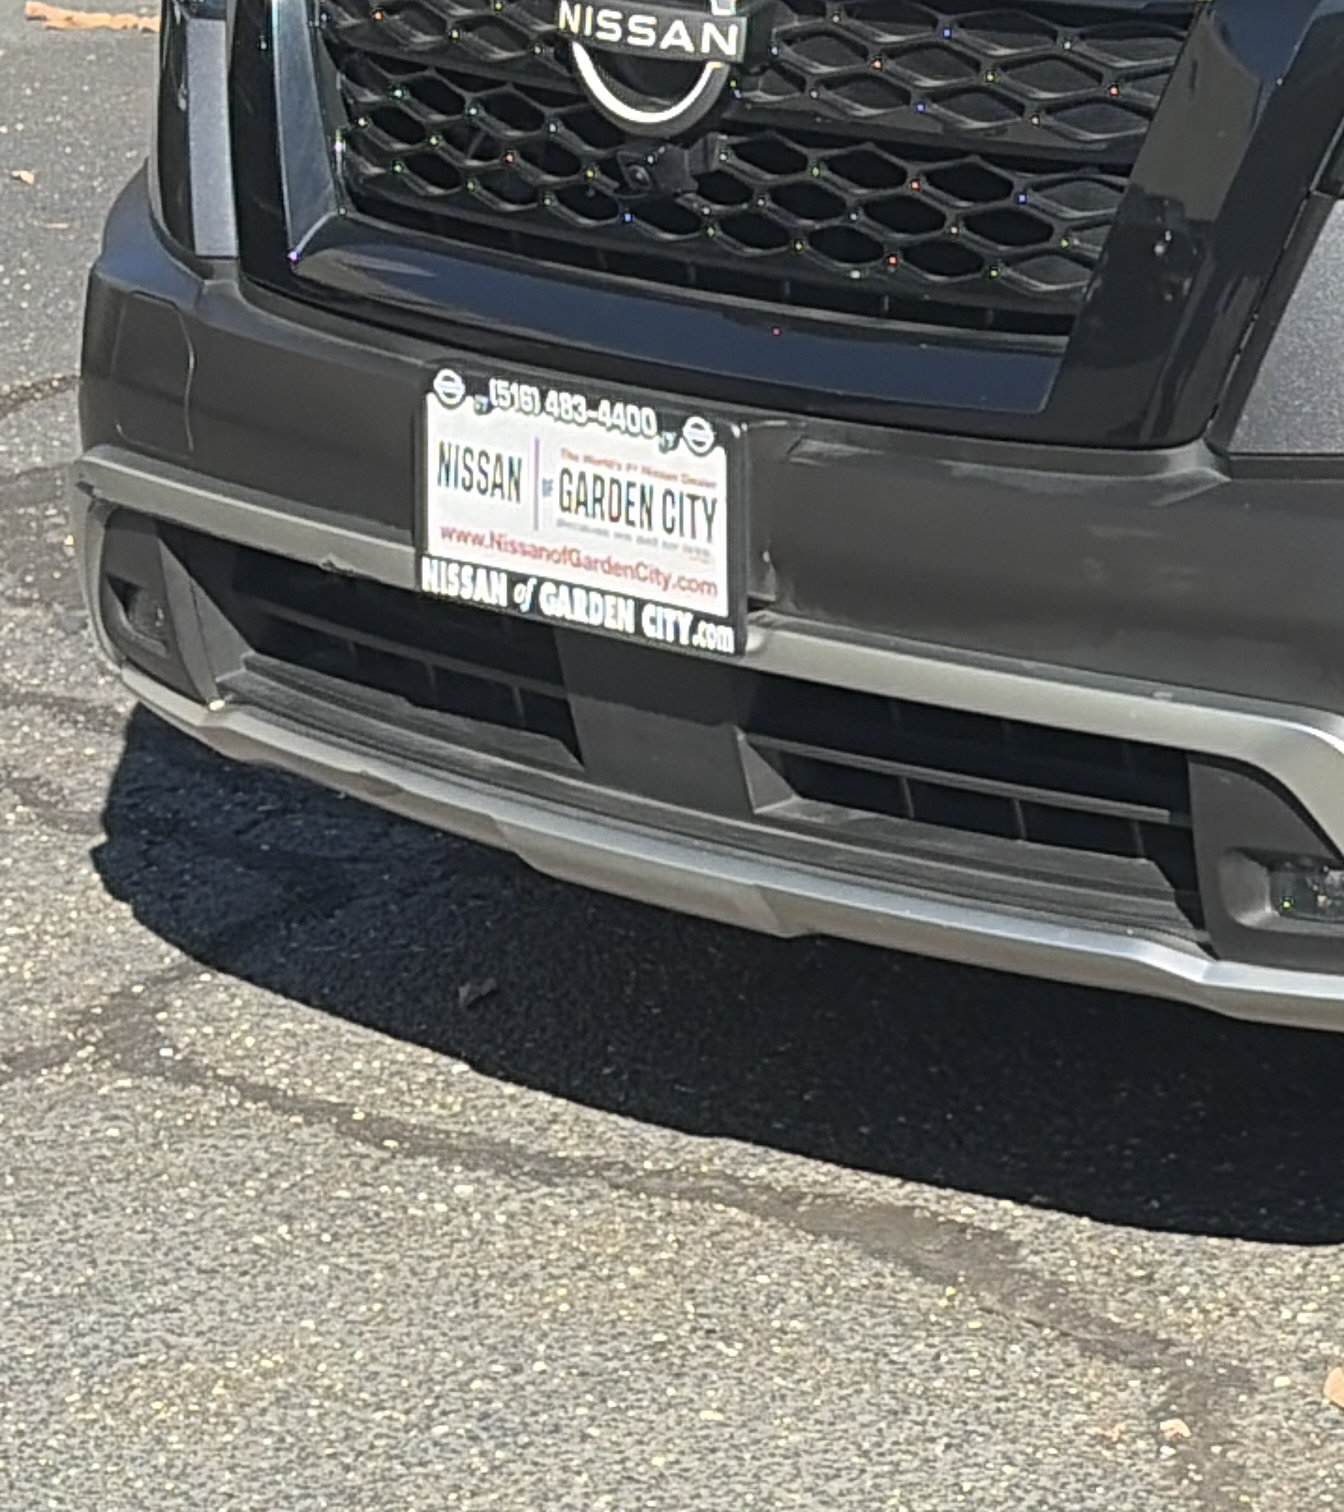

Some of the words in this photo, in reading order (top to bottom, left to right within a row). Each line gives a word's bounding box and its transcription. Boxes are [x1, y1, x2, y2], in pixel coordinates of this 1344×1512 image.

[558, 0, 739, 56] NISSAN
[489, 377, 541, 416] (516)
[544, 389, 658, 437] 483-4400
[437, 440, 522, 504] NISSAN
[558, 467, 654, 532] GARDEN
[661, 488, 718, 544] CITY
[421, 555, 508, 607] NISSAN
[513, 577, 538, 613] of
[538, 581, 636, 635] GARDEN
[440, 525, 718, 597] www.NissanofGardenCity.com
